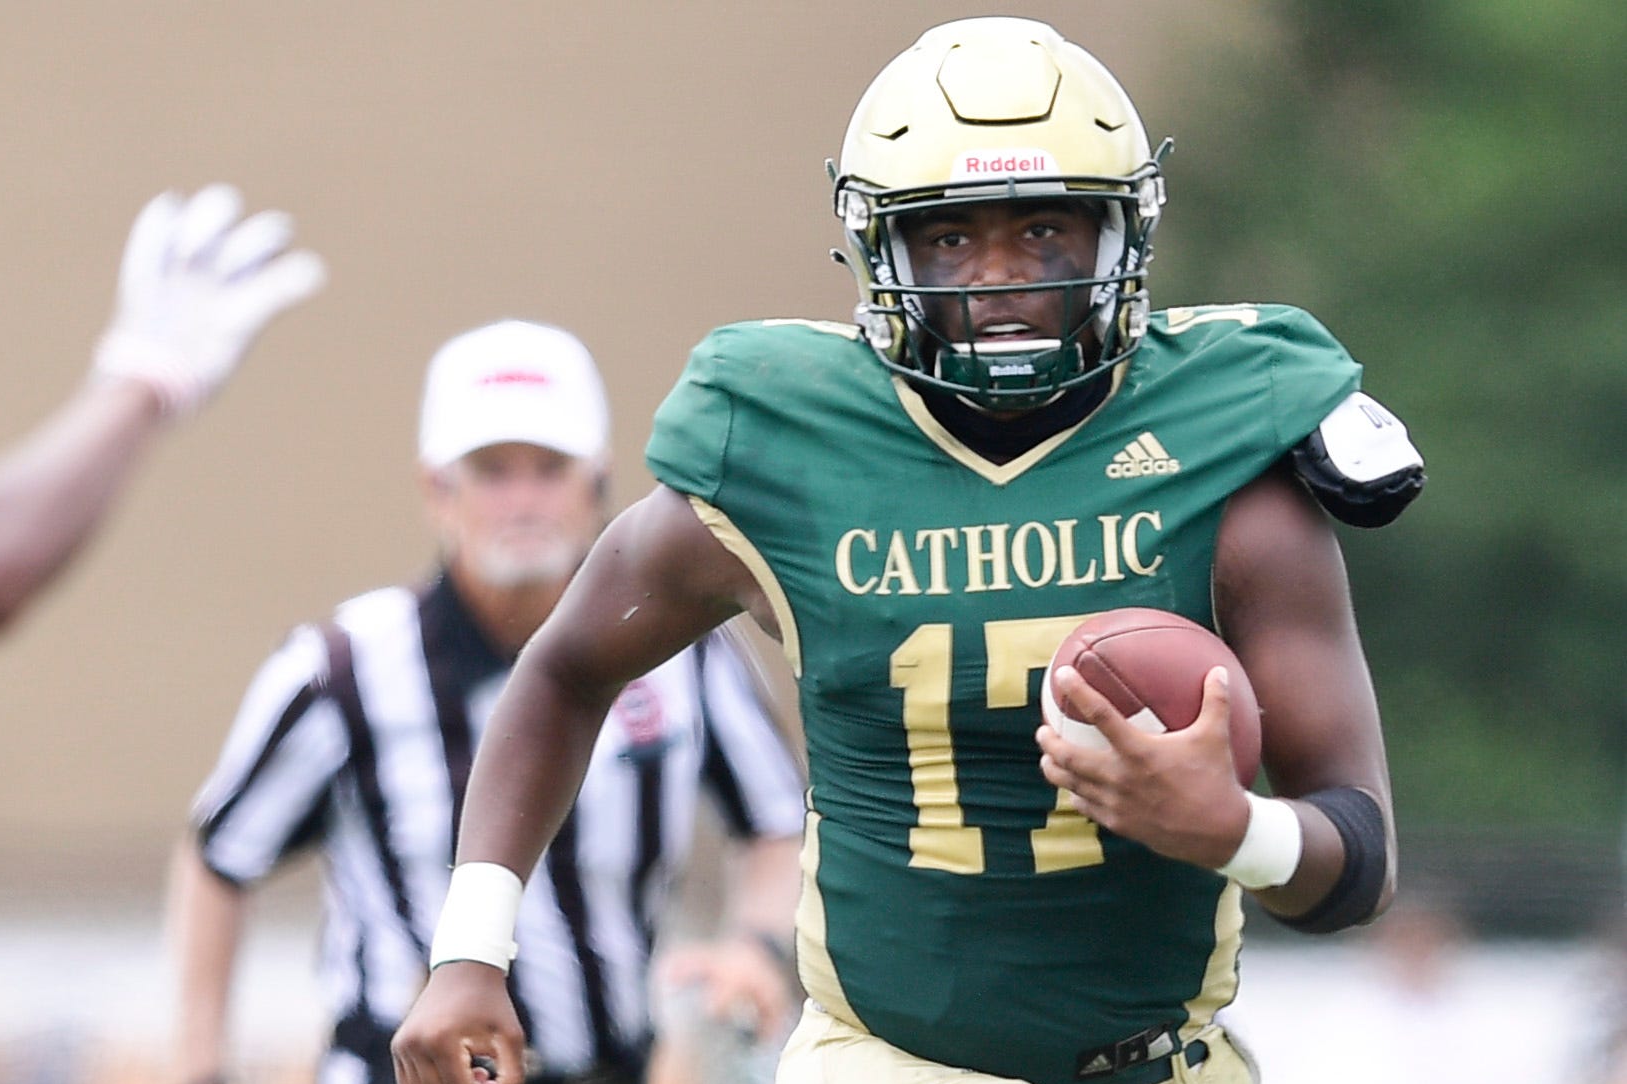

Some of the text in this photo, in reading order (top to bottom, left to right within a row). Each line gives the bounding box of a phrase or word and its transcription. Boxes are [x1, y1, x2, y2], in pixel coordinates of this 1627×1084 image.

[965, 156, 1045, 172] Riddell
[1105, 458, 1180, 480] adidas
[834, 510, 1164, 595] CATHOLIC
[889, 612, 1106, 875] 17
